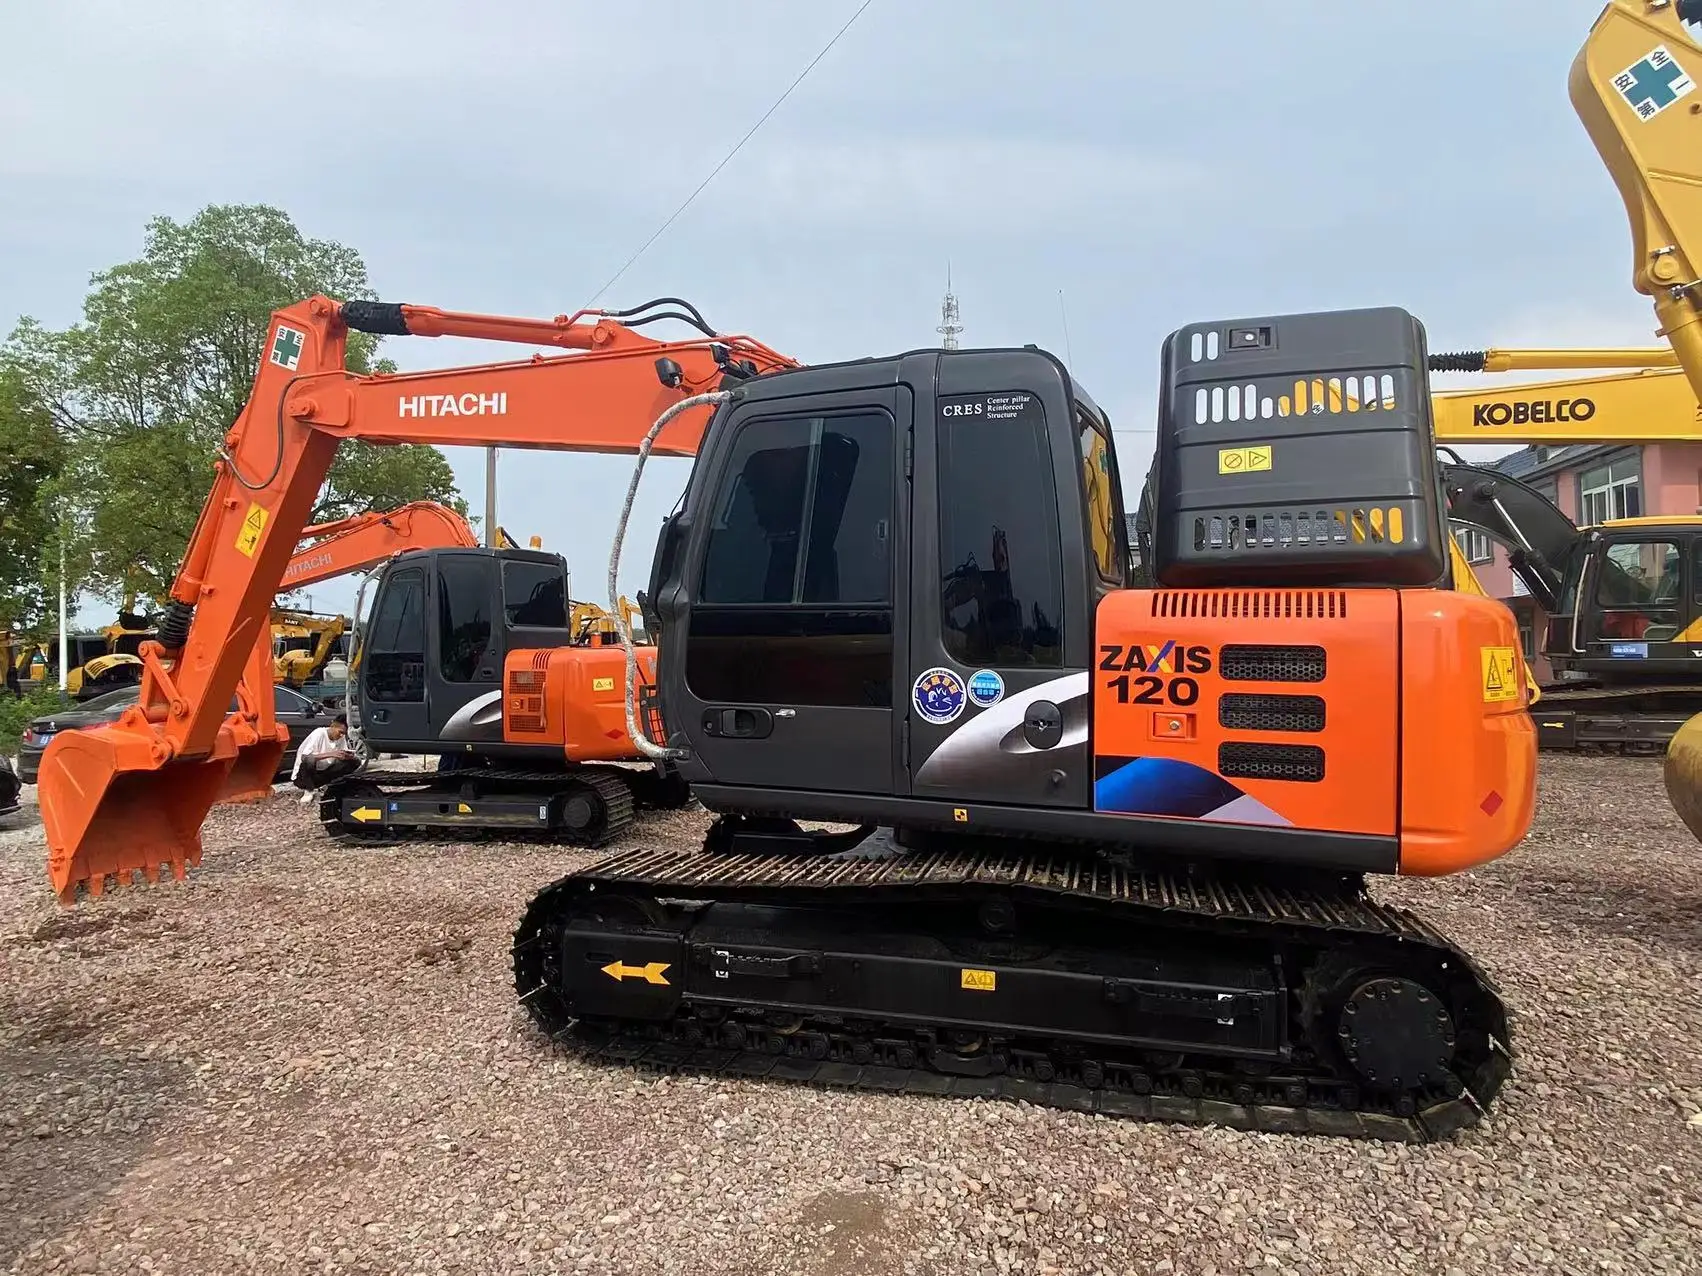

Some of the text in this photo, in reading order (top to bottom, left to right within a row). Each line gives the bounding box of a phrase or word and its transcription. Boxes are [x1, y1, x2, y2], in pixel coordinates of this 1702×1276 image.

[399, 391, 507, 418] HITACHI
[942, 403, 983, 416] CRES
[986, 395, 1031, 405] Center pillar
[986, 403, 1024, 412] Reinforced
[986, 411, 1018, 419] Structure
[1473, 398, 1596, 426] KOBELCO
[1099, 640, 1212, 674] ZAXIS
[1107, 675, 1199, 706] 120
